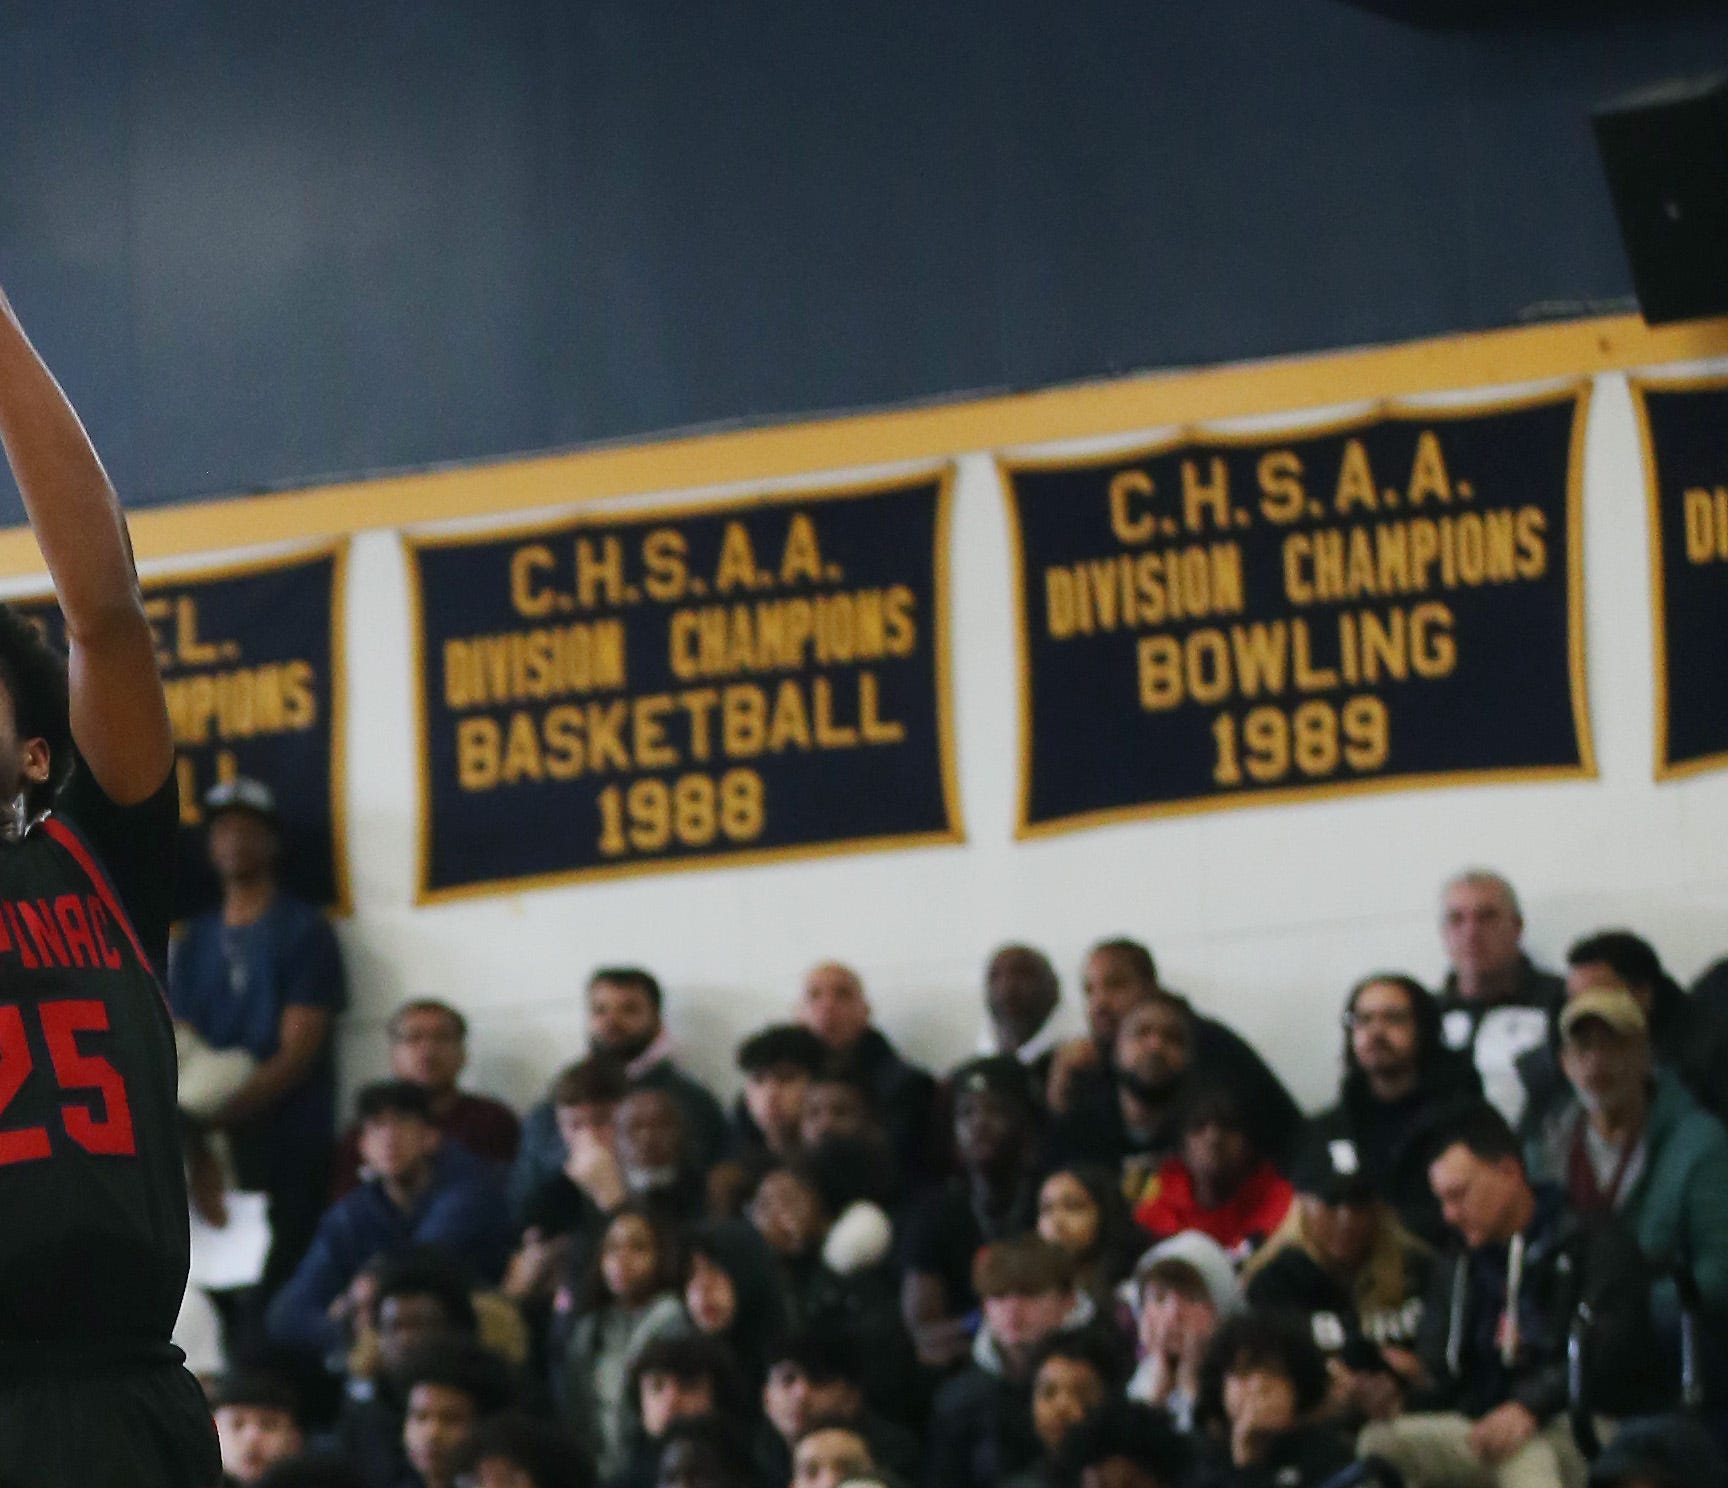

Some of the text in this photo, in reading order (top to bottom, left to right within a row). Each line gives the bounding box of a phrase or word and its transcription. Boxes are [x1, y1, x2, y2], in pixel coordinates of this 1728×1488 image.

[1108, 429, 1473, 545] C.H.S.A.A.
[508, 512, 843, 618] C.H.S.A.A.
[1045, 505, 1548, 641] DIVISION CHAMPIONS
[443, 583, 916, 708] DIVISION CHAMPIONS
[1136, 602, 1458, 711] BOWLING
[456, 671, 905, 791] BASKETBALL
[1211, 694, 1390, 786] 1989
[595, 768, 766, 856] 1988
